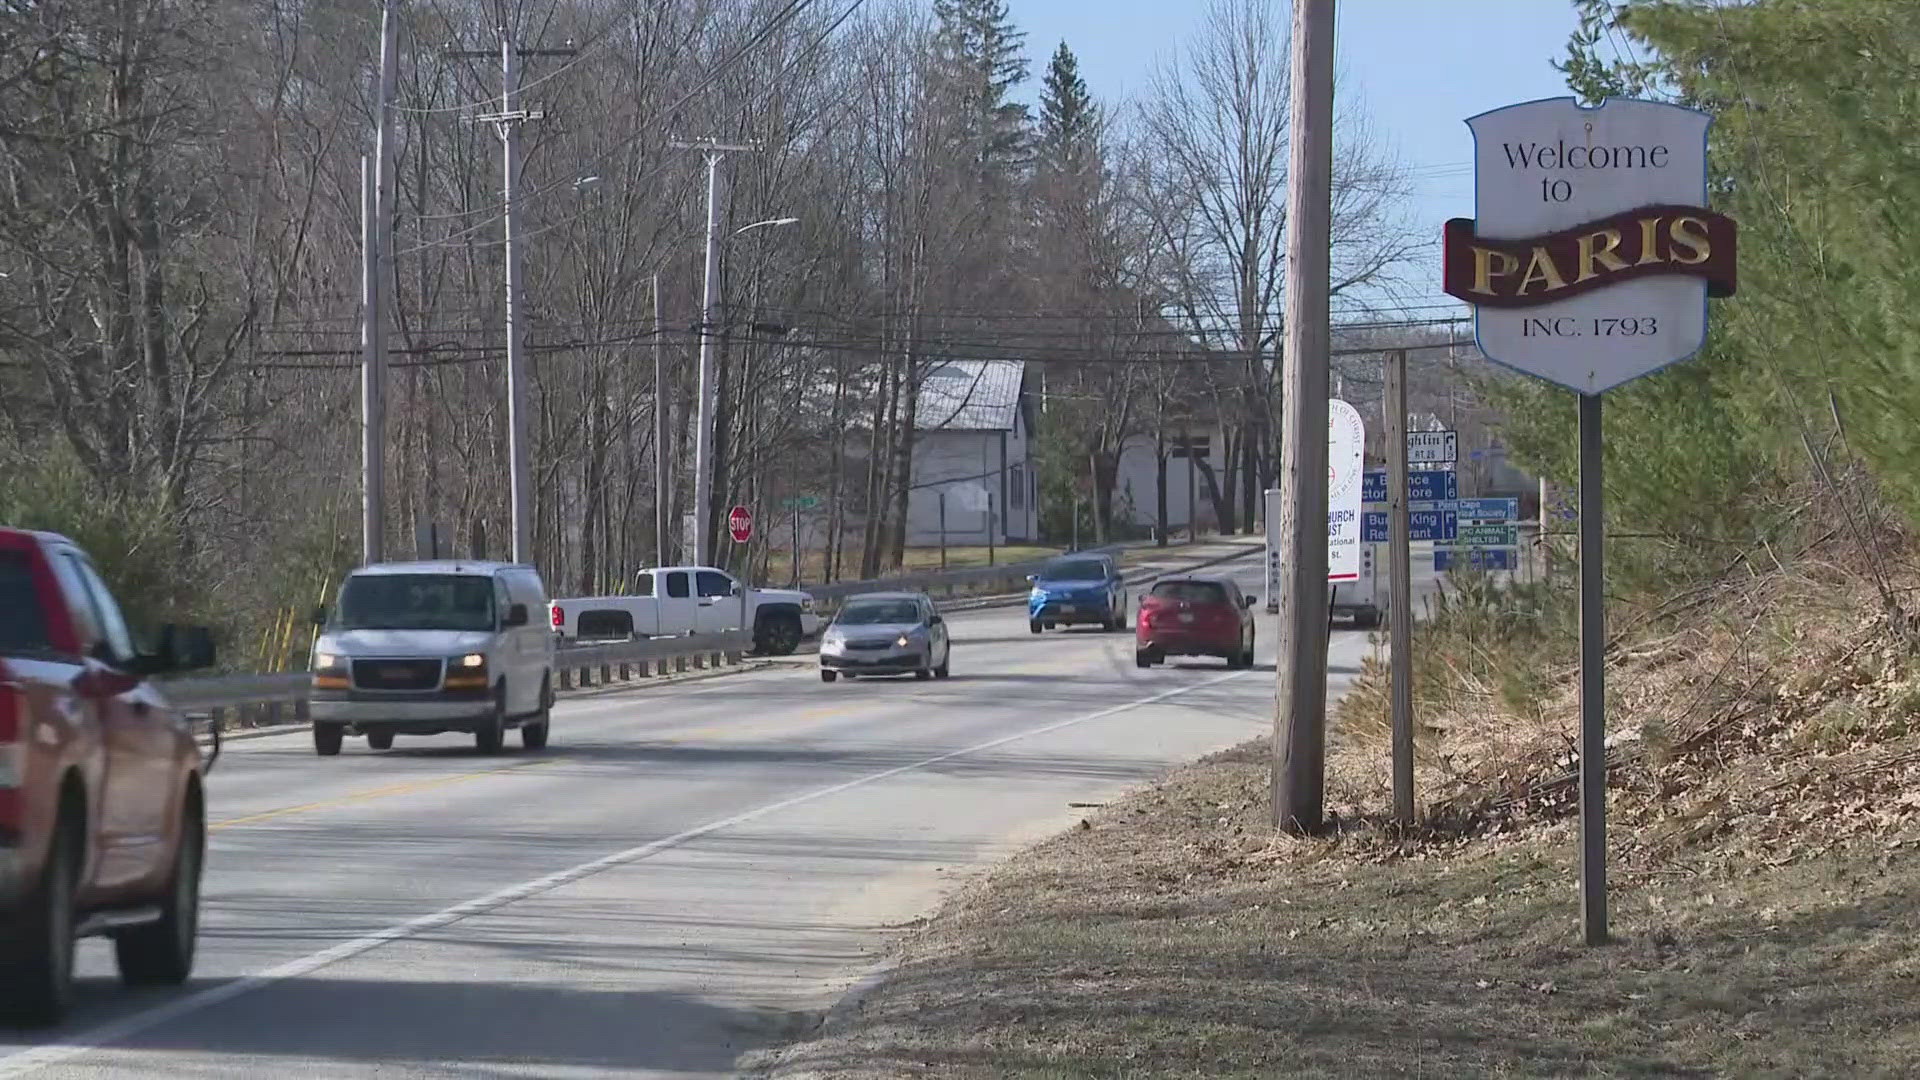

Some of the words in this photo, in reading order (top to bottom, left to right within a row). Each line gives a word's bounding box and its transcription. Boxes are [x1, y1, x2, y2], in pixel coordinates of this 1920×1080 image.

[1503, 140, 1669, 169] Welcome
[1542, 177, 1572, 202] to
[1469, 216, 1712, 296] PARIS
[1523, 318, 1582, 337] INC.
[1594, 318, 1658, 336] 1793
[1408, 434, 1440, 448] ghlin
[1328, 509, 1355, 523] HURCH
[1411, 513, 1437, 526] King
[731, 517, 751, 531] STOP
[1329, 537, 1355, 546] ational
